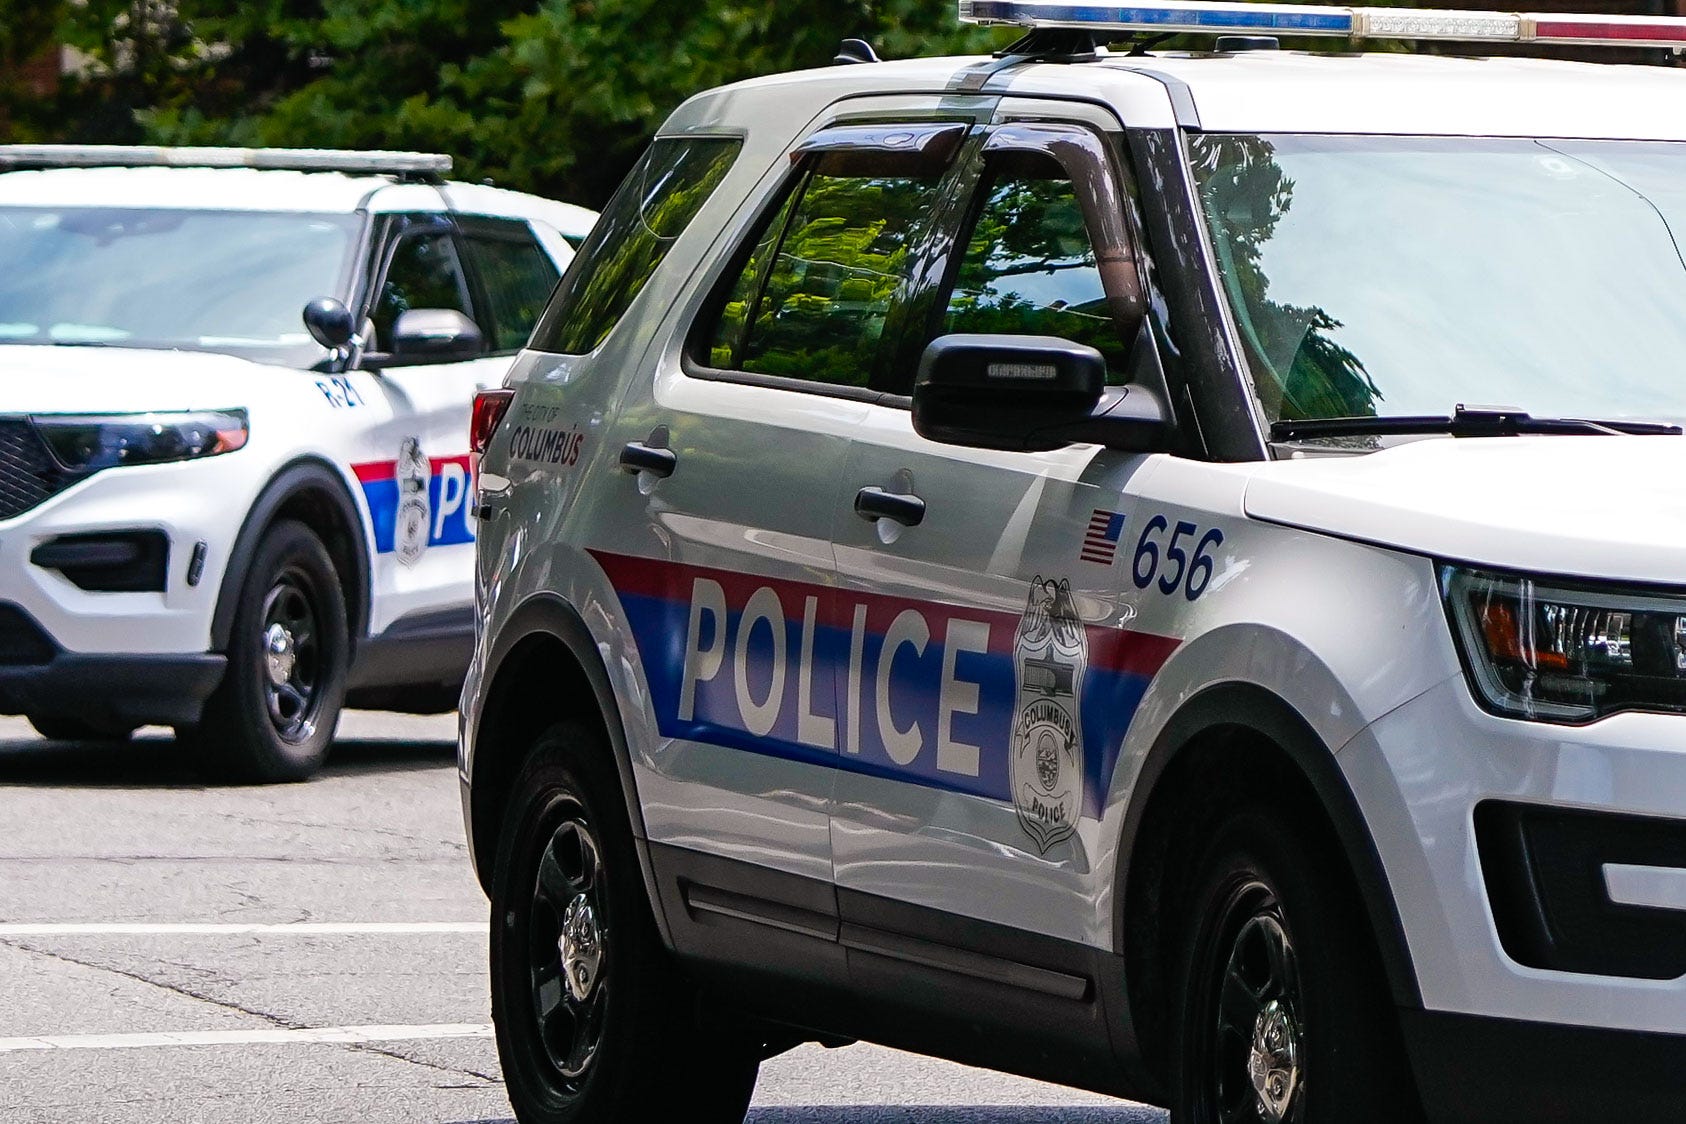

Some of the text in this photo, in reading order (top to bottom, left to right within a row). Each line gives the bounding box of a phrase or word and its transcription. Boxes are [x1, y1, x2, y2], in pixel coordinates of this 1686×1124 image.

[509, 425, 584, 467] COLUMBUS
[1132, 514, 1224, 601] 656
[677, 577, 990, 777] POLICE
[1024, 704, 1072, 736] COLUMBUS
[1032, 796, 1066, 825] POLICE
